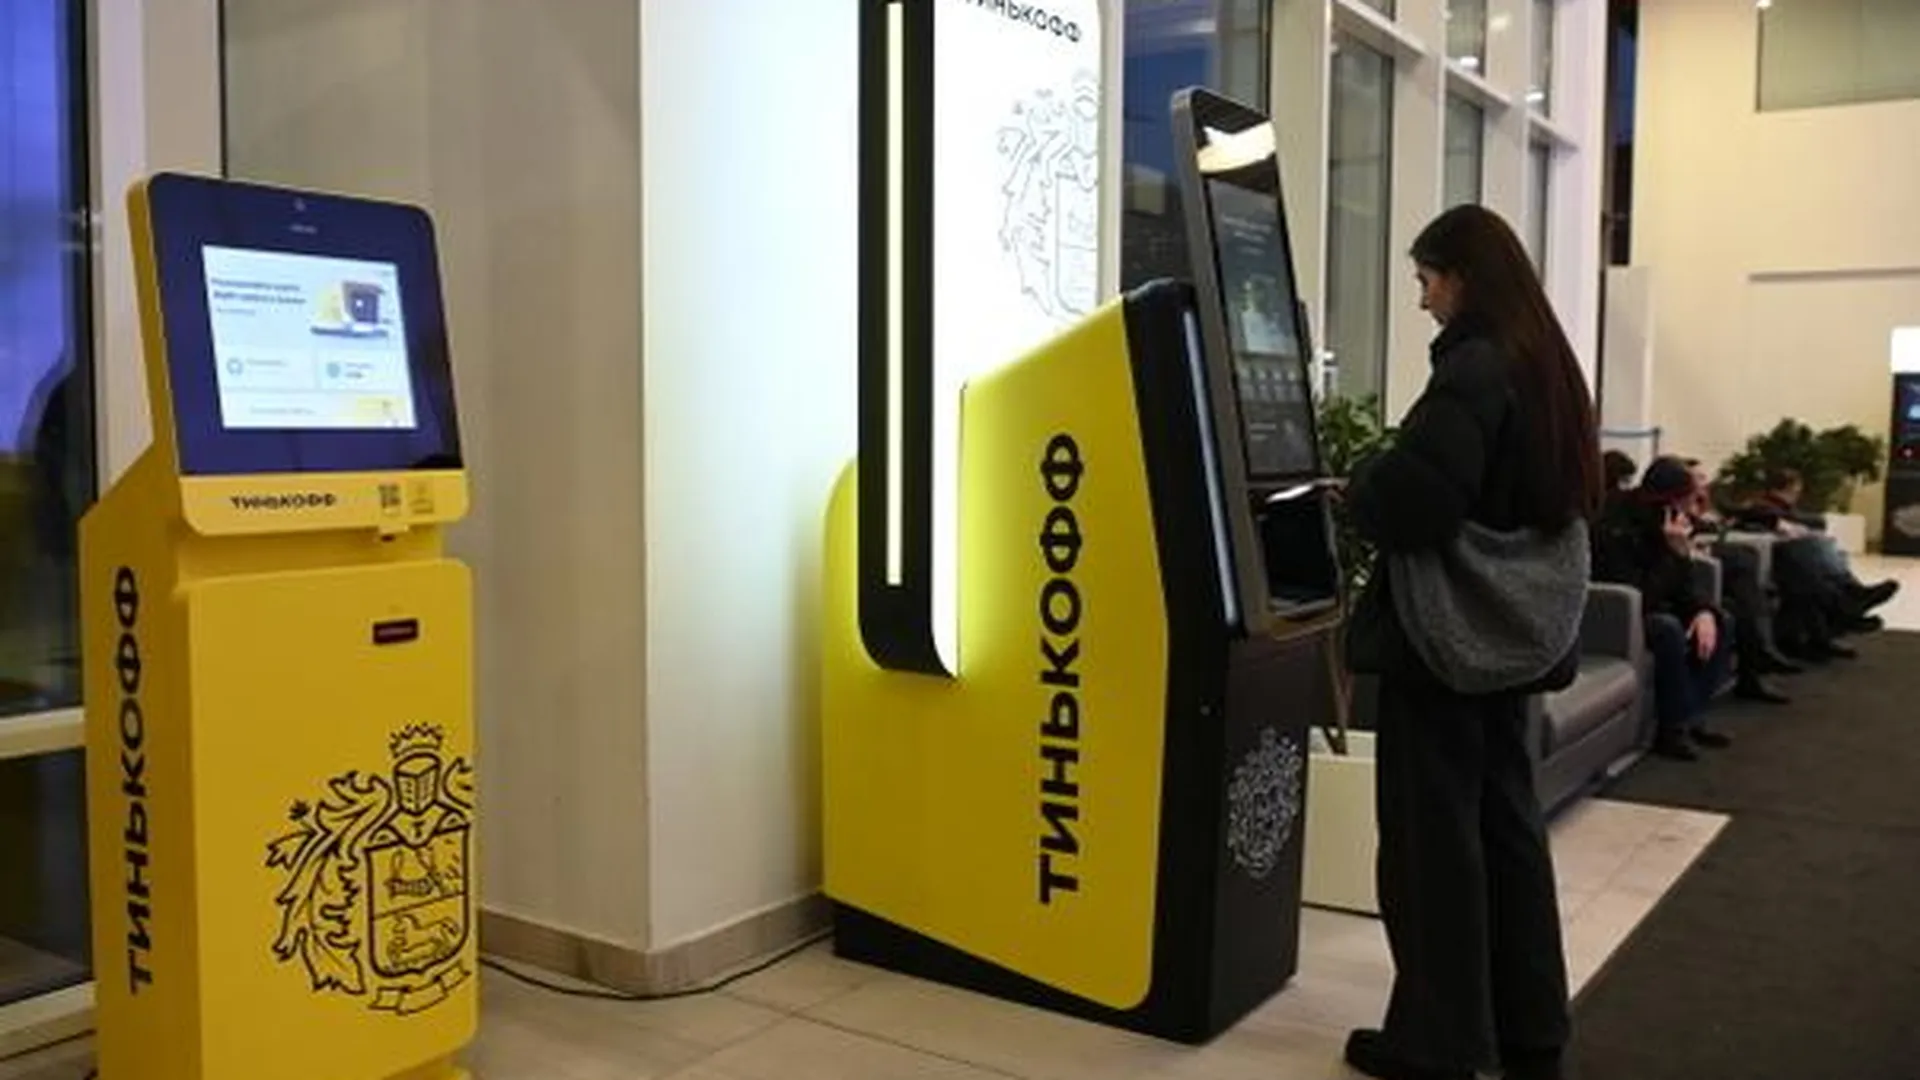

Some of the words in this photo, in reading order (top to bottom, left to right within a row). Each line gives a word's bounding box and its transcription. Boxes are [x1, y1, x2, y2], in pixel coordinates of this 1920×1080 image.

[966, 0, 1082, 42] НЬКОФФ
[115, 566, 153, 996] ТИНЬКОФФ
[1039, 433, 1085, 905] ТИНЬКОФФ
